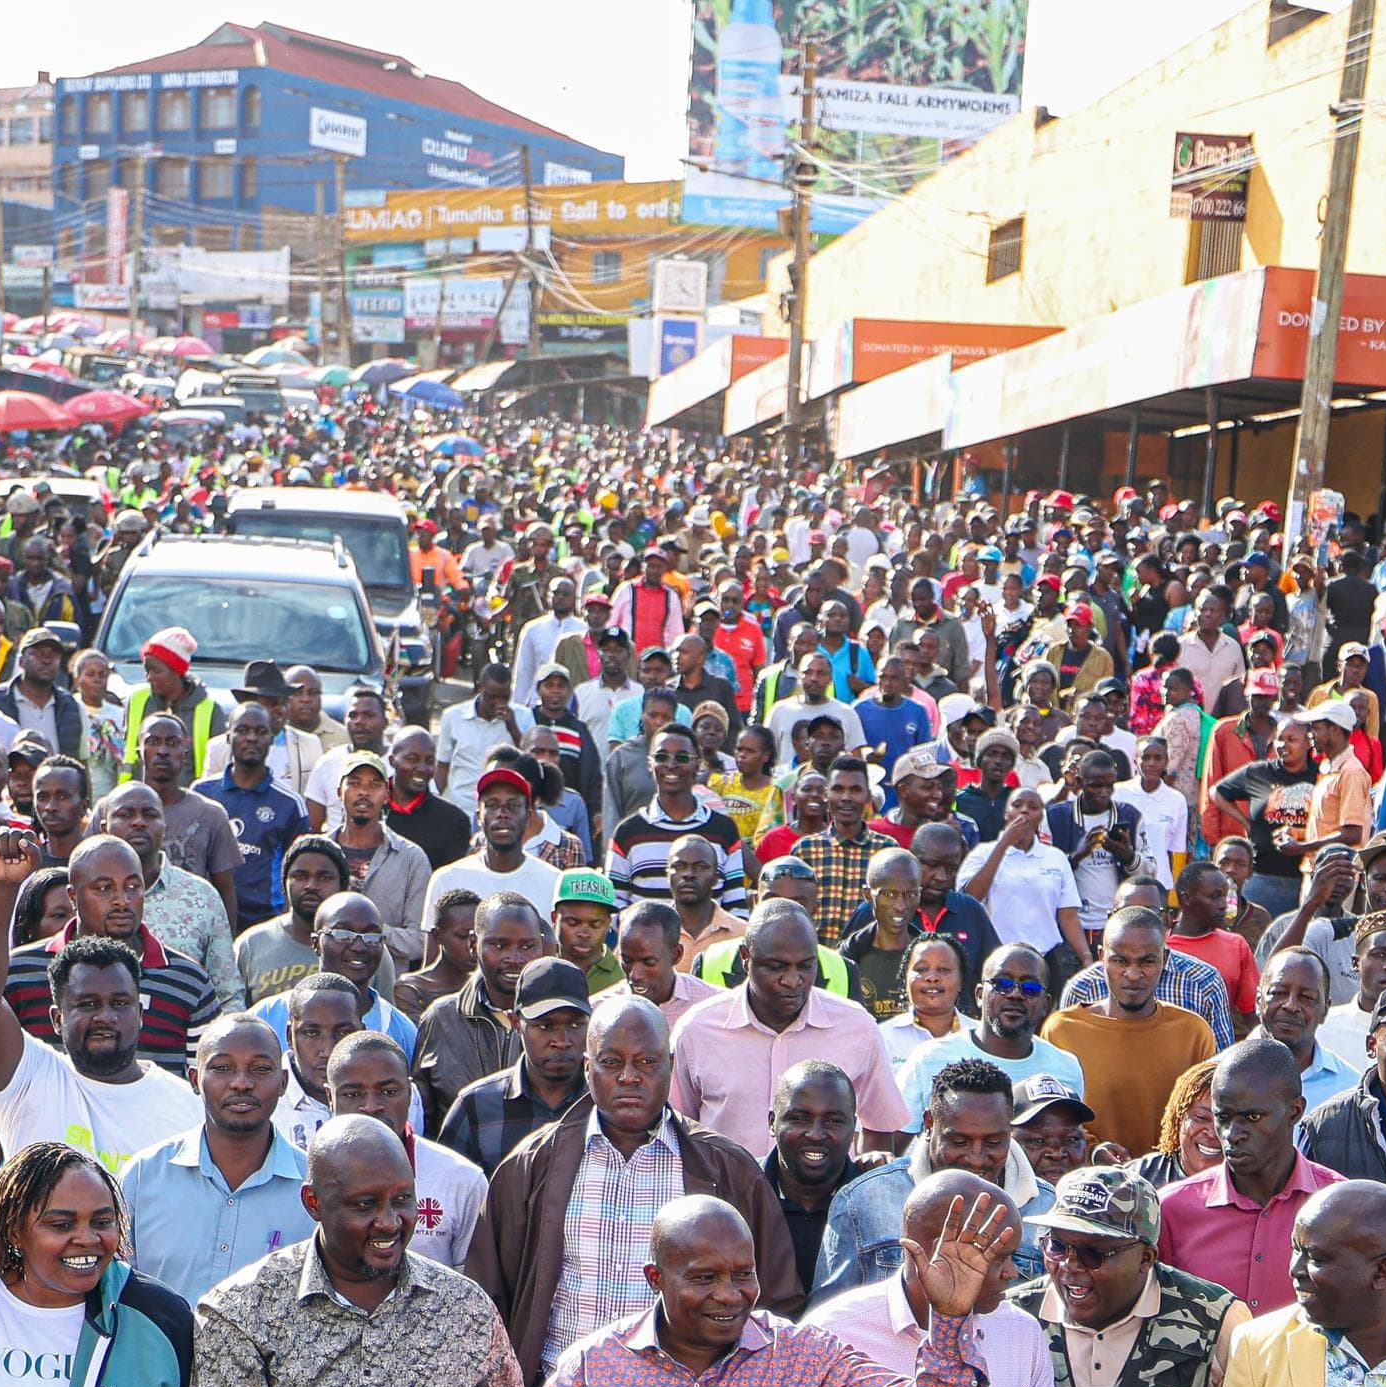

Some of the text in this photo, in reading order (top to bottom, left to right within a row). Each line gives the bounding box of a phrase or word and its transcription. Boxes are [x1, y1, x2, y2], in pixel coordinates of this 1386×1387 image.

[878, 93, 911, 108] FALL
[916, 97, 1011, 116] ARMYWORMS
[607, 199, 627, 220] to
[570, 881, 611, 899] TREASURE
